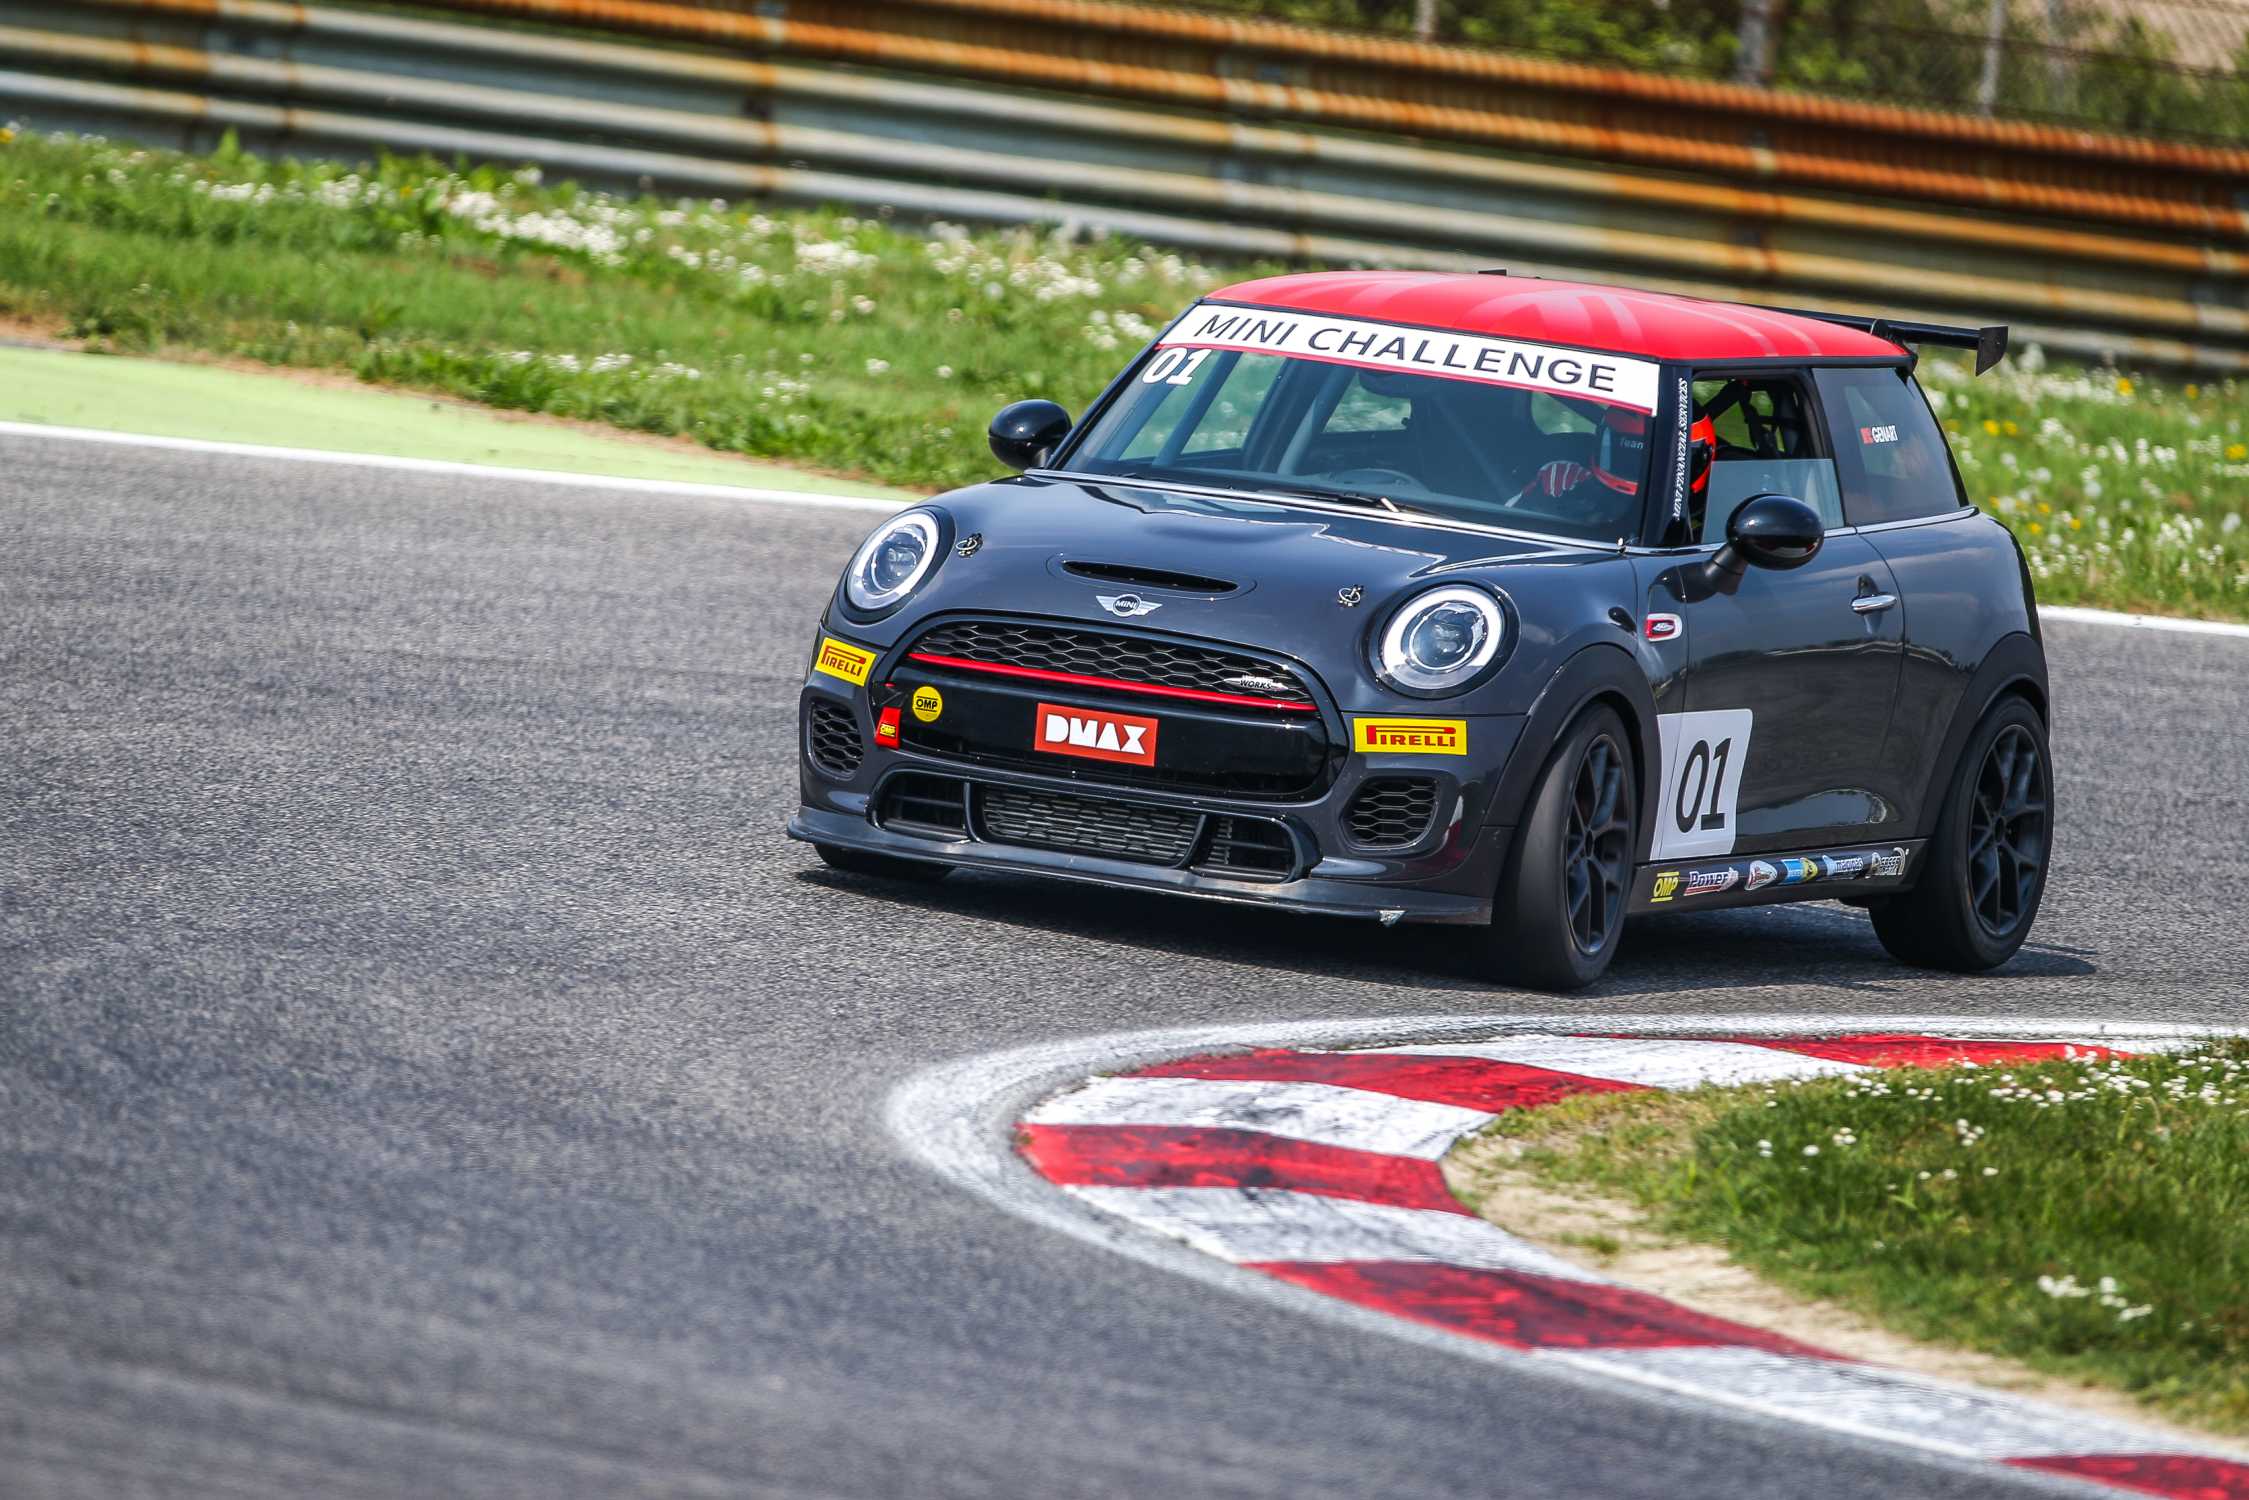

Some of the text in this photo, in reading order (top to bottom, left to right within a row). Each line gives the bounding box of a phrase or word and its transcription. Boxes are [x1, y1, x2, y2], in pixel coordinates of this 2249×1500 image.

[1142, 346, 1212, 385] 01
[1193, 314, 1617, 392] MINI CHALLENGE
[1678, 377, 1688, 431] SERVICES
[1675, 430, 1688, 491] FINANCIAL
[1115, 600, 1137, 609] MINI
[820, 644, 866, 677] PIRELLI
[1240, 679, 1272, 689] WORKS
[915, 698, 938, 710] OMP
[1045, 713, 1147, 755] DMAX
[1366, 725, 1456, 747] PIRELLI
[1676, 737, 1732, 833] 01
[1653, 876, 1679, 898] OMP
